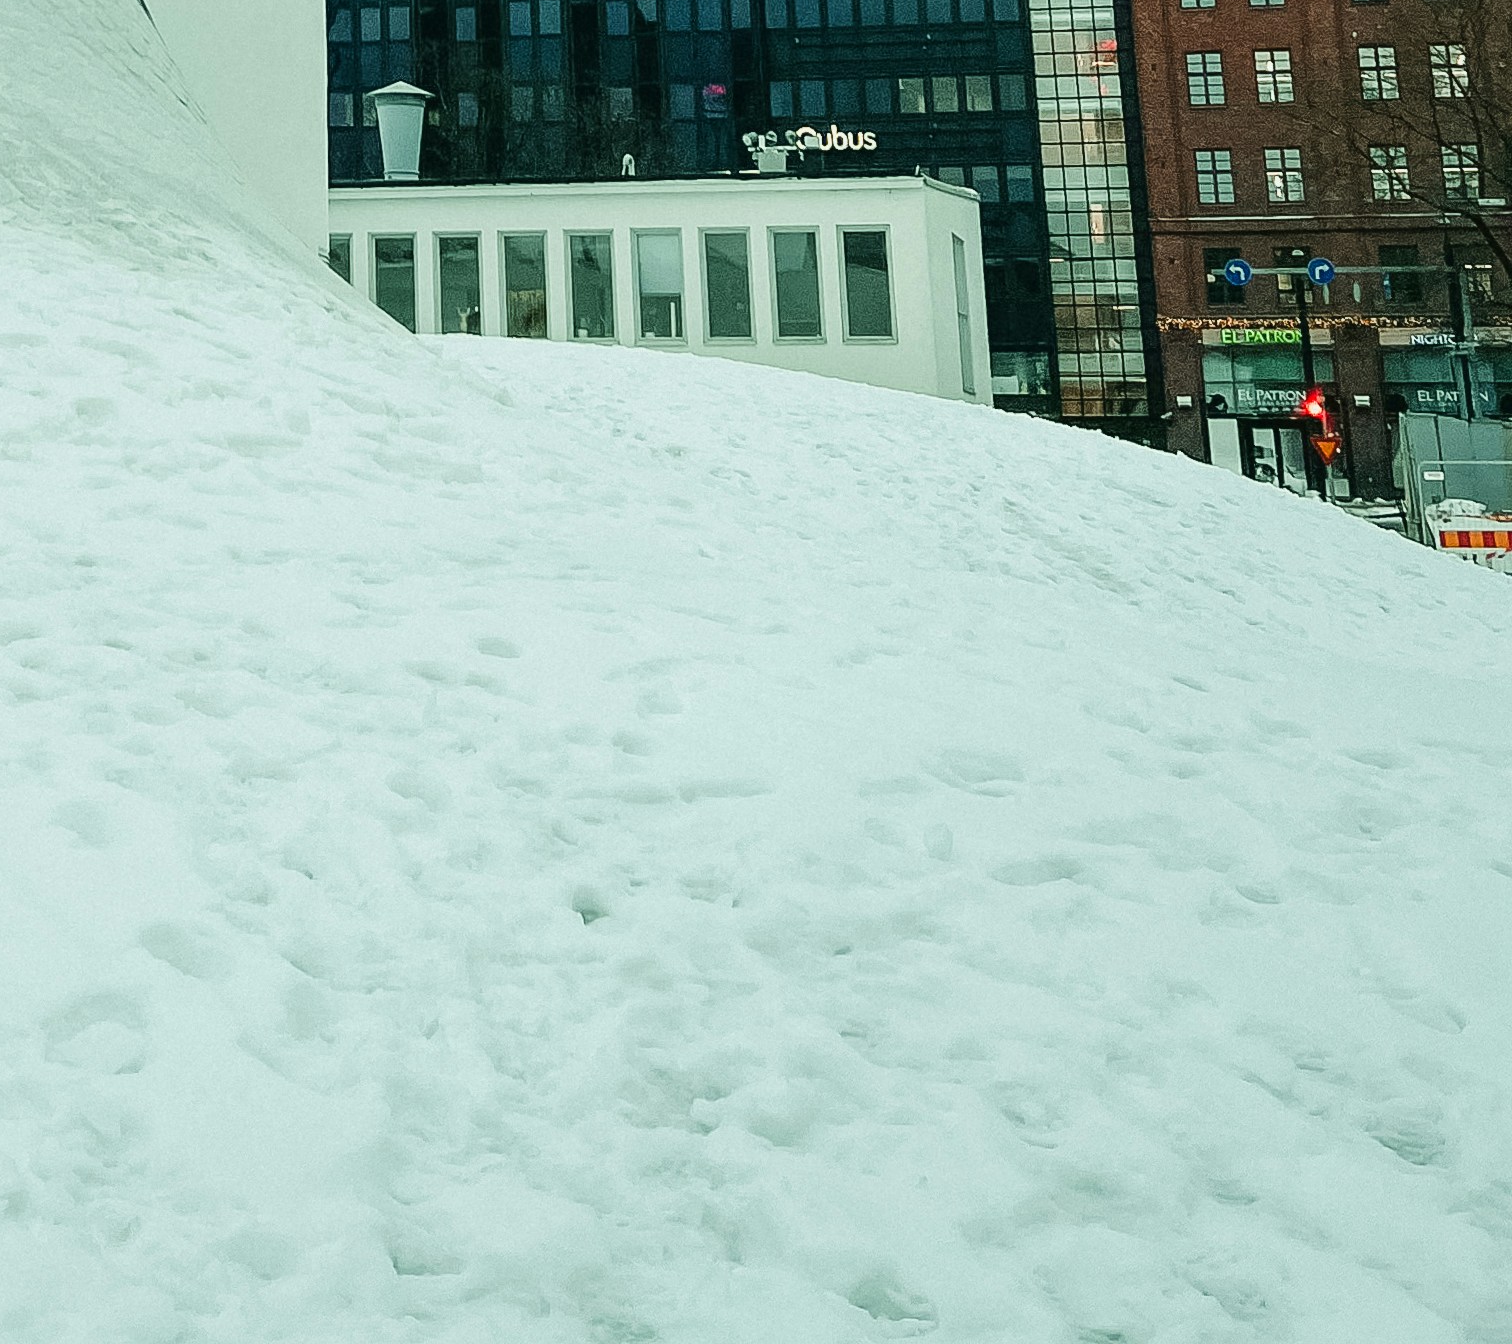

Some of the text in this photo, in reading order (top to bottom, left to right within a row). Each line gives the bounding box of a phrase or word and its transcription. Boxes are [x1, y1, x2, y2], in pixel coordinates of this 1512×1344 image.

[796, 124, 877, 151] Cubus
[1221, 329, 1239, 343] EL
[1237, 389, 1306, 402] EL PATRON
[1417, 390, 1434, 402] EL
